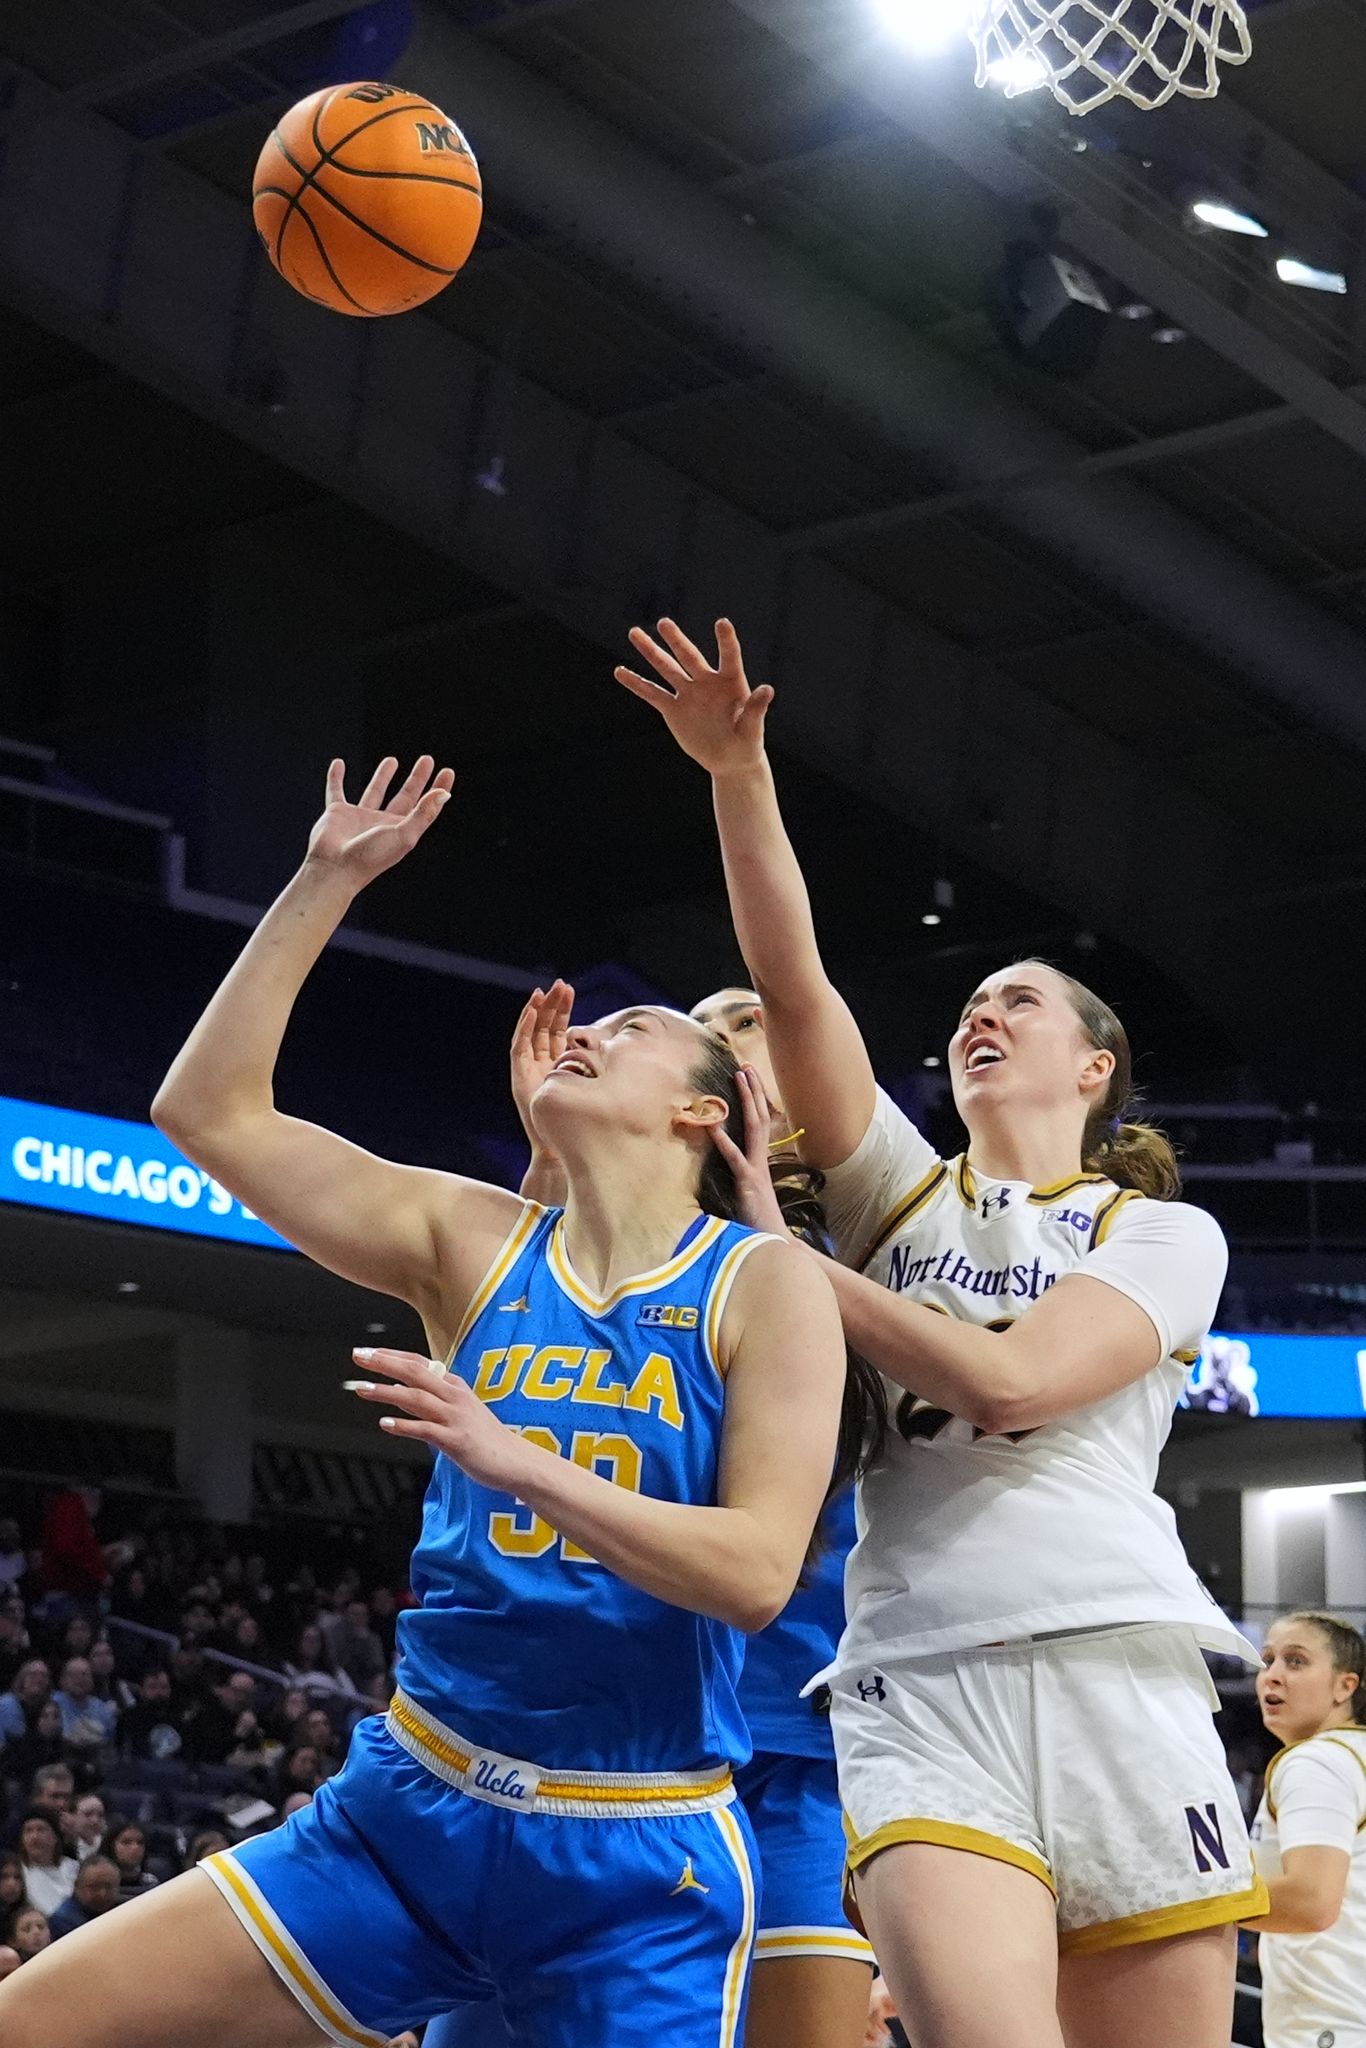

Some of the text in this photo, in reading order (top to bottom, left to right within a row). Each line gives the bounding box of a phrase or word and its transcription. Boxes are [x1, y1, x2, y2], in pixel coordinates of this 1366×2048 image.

[12, 1136, 233, 1215] CHICAGO'S
[472, 1343, 685, 1432] UCLA
[474, 1760, 526, 1800] Ucla
[1183, 1802, 1231, 1873] N
